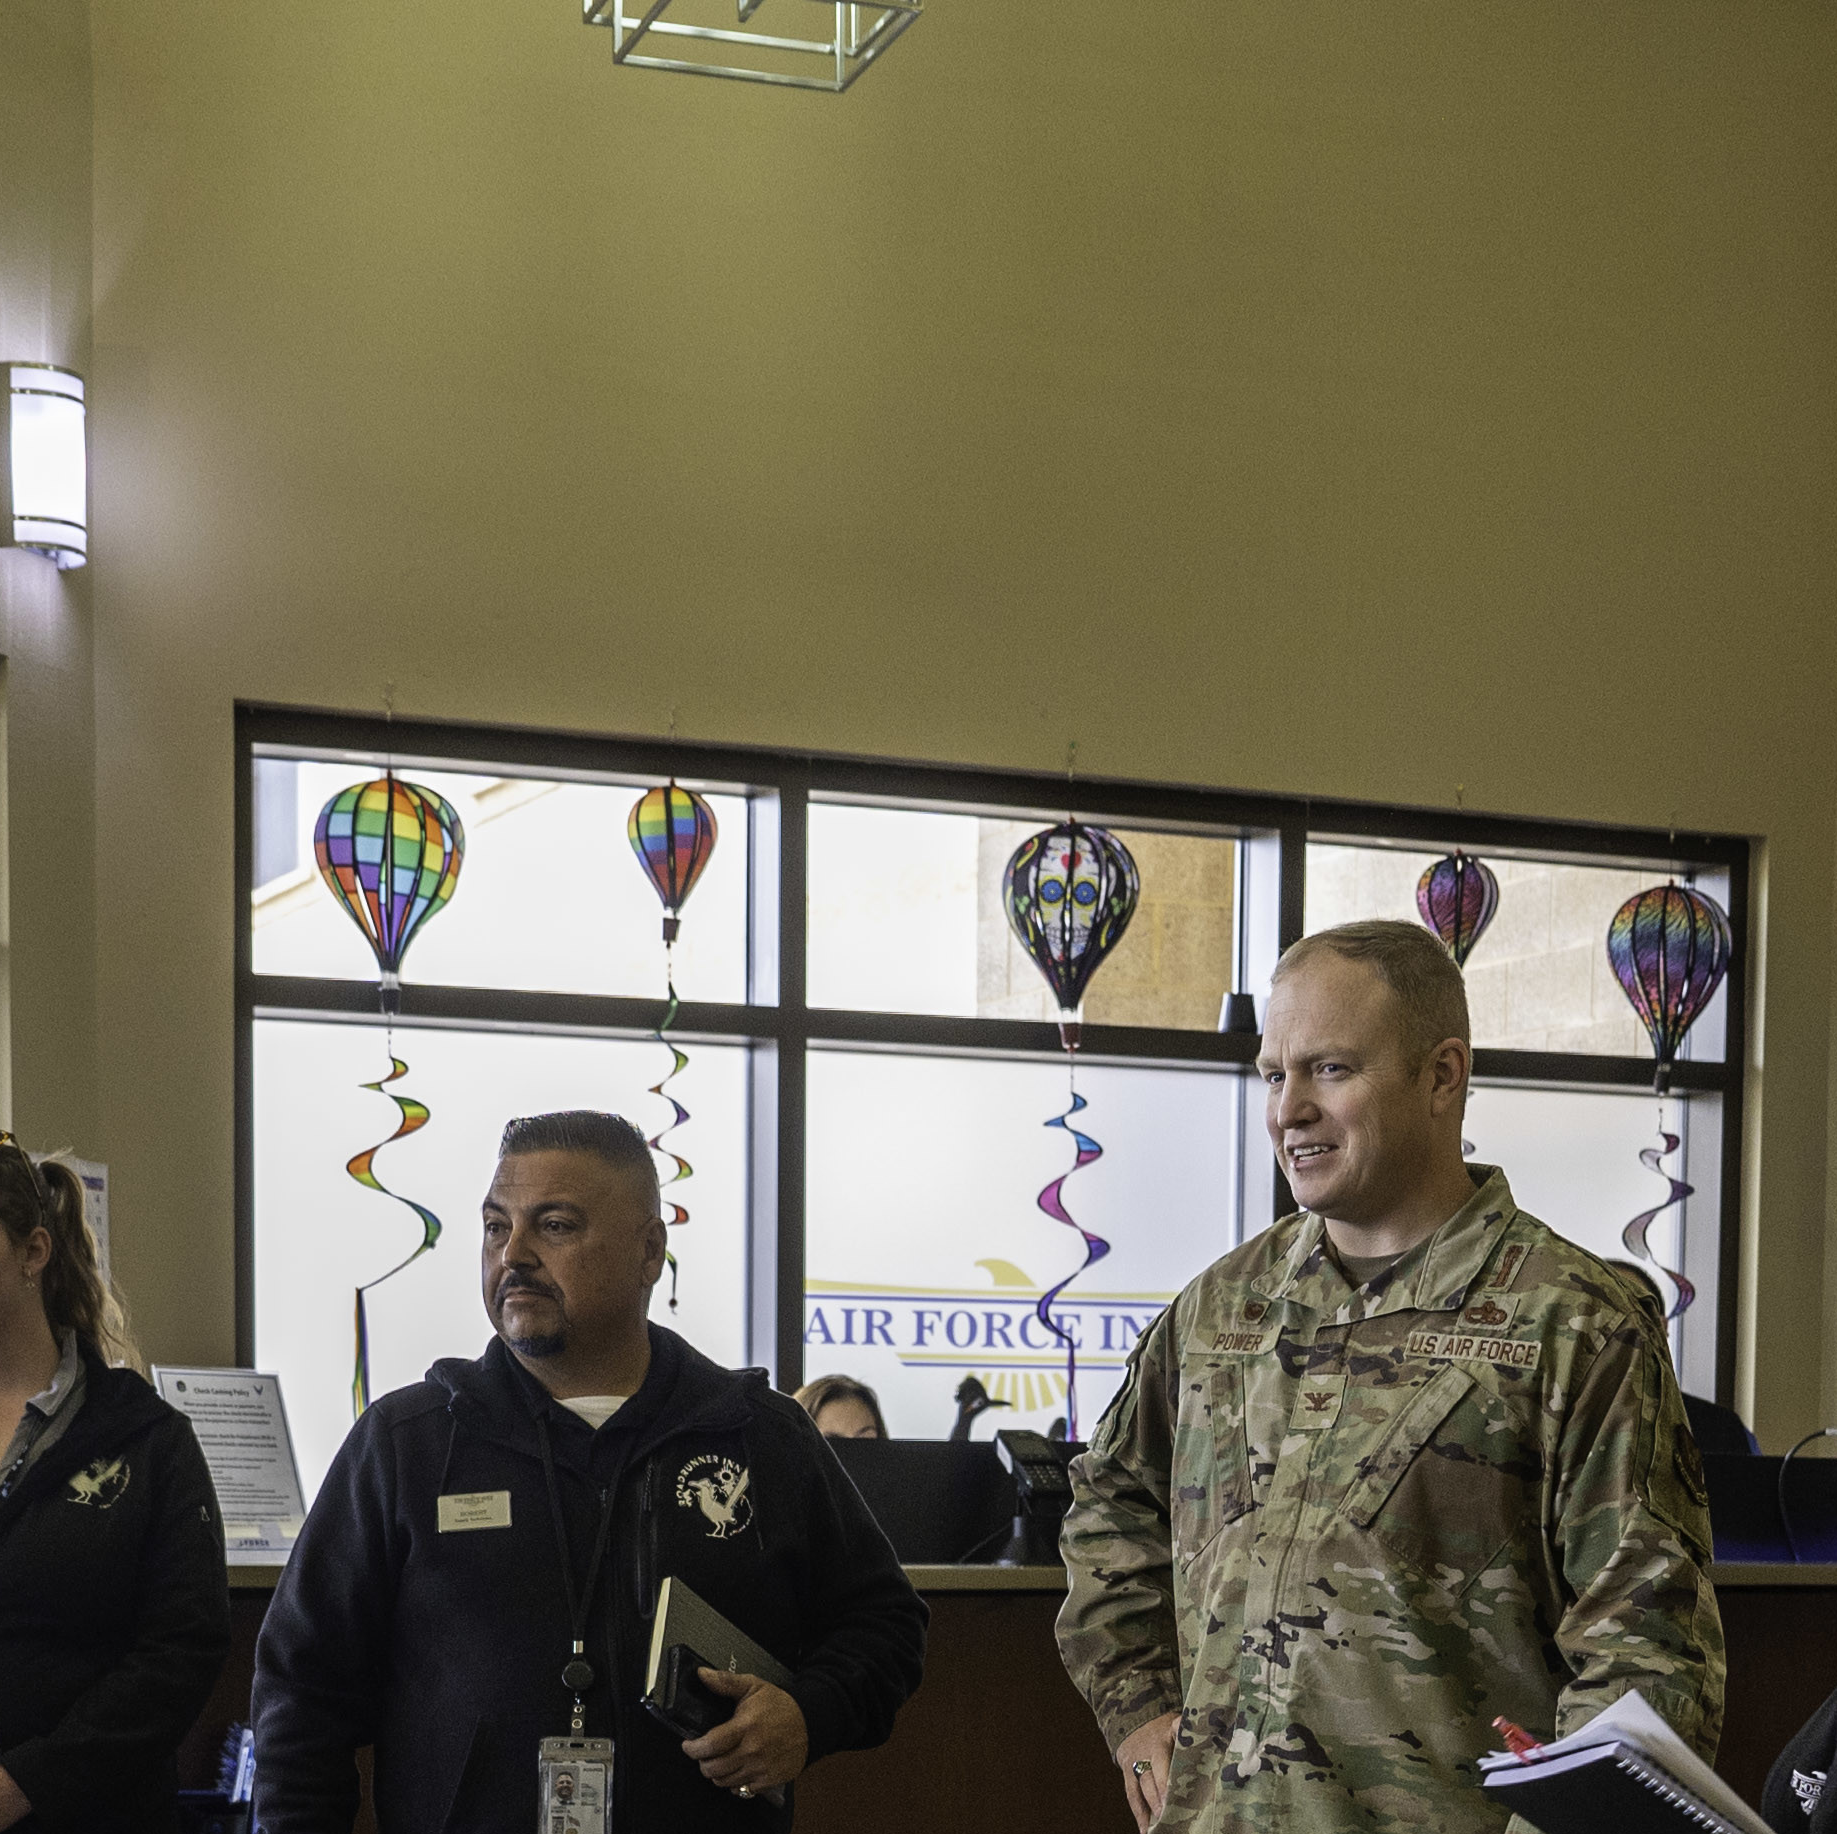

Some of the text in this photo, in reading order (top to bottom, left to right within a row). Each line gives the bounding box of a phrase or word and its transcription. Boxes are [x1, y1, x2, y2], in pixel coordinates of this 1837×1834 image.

[803, 1307, 1153, 1351] AIR FORCE IN
[1212, 1333, 1264, 1351] POWER
[1410, 1334, 1538, 1365] U.S. AIR FORCE
[1799, 1780, 1822, 1796] FOR
